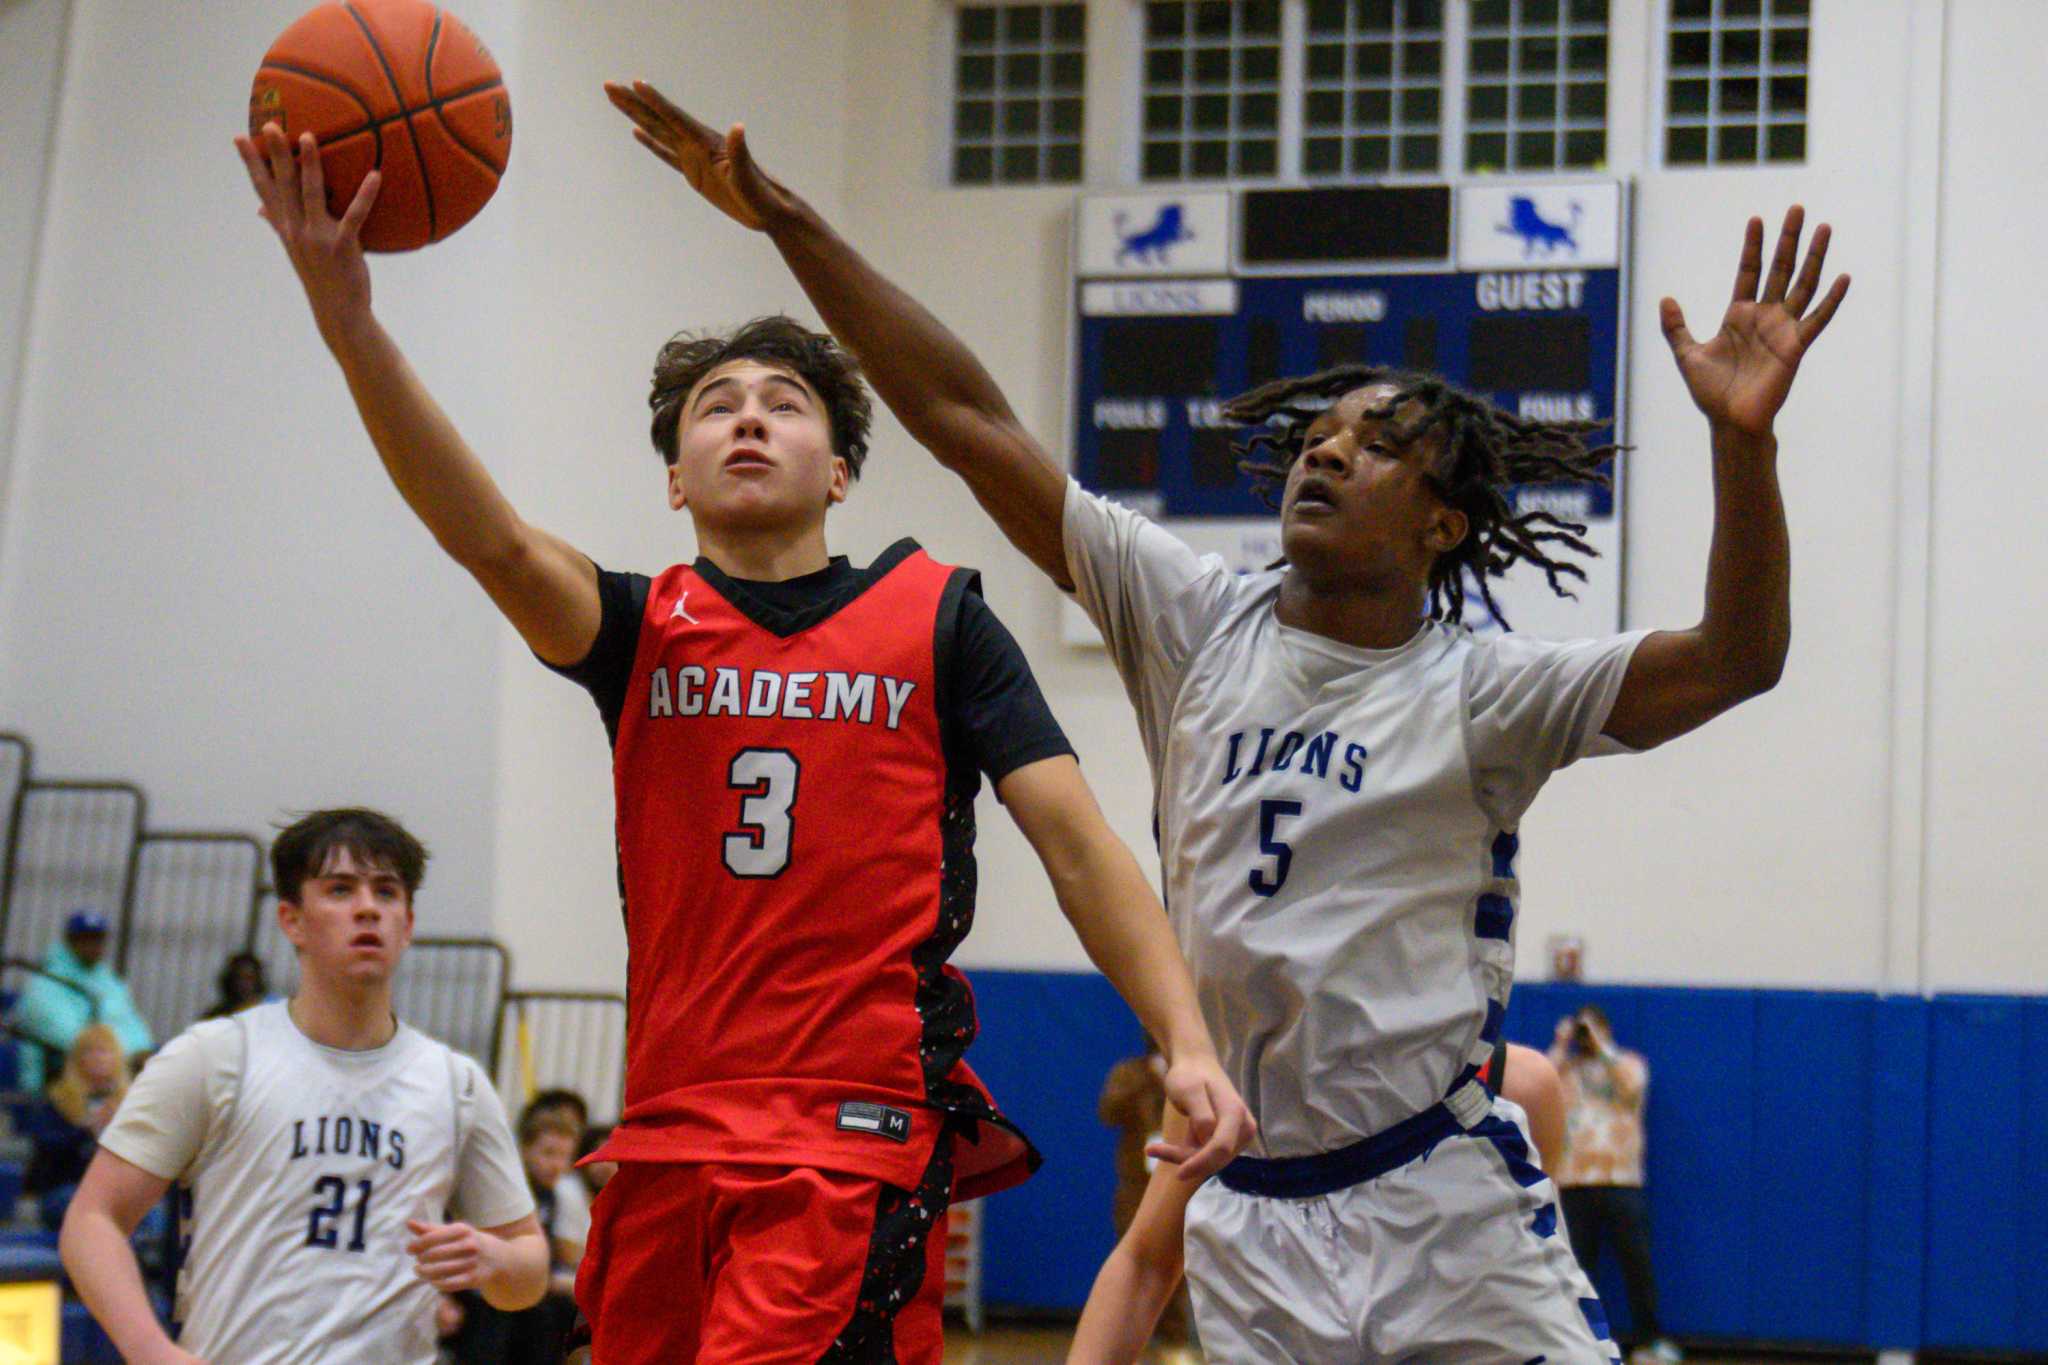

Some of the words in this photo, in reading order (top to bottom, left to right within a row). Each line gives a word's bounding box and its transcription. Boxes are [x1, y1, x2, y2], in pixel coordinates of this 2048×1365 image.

[1476, 272, 1583, 310] GUEST
[649, 665, 917, 731] ACADEMY
[1222, 727, 1368, 794] LIONS
[721, 745, 801, 880] 3
[1249, 799, 1303, 898] 5
[290, 1115, 405, 1171] LIONS
[889, 1114, 904, 1131] M
[304, 1174, 373, 1252] 21
